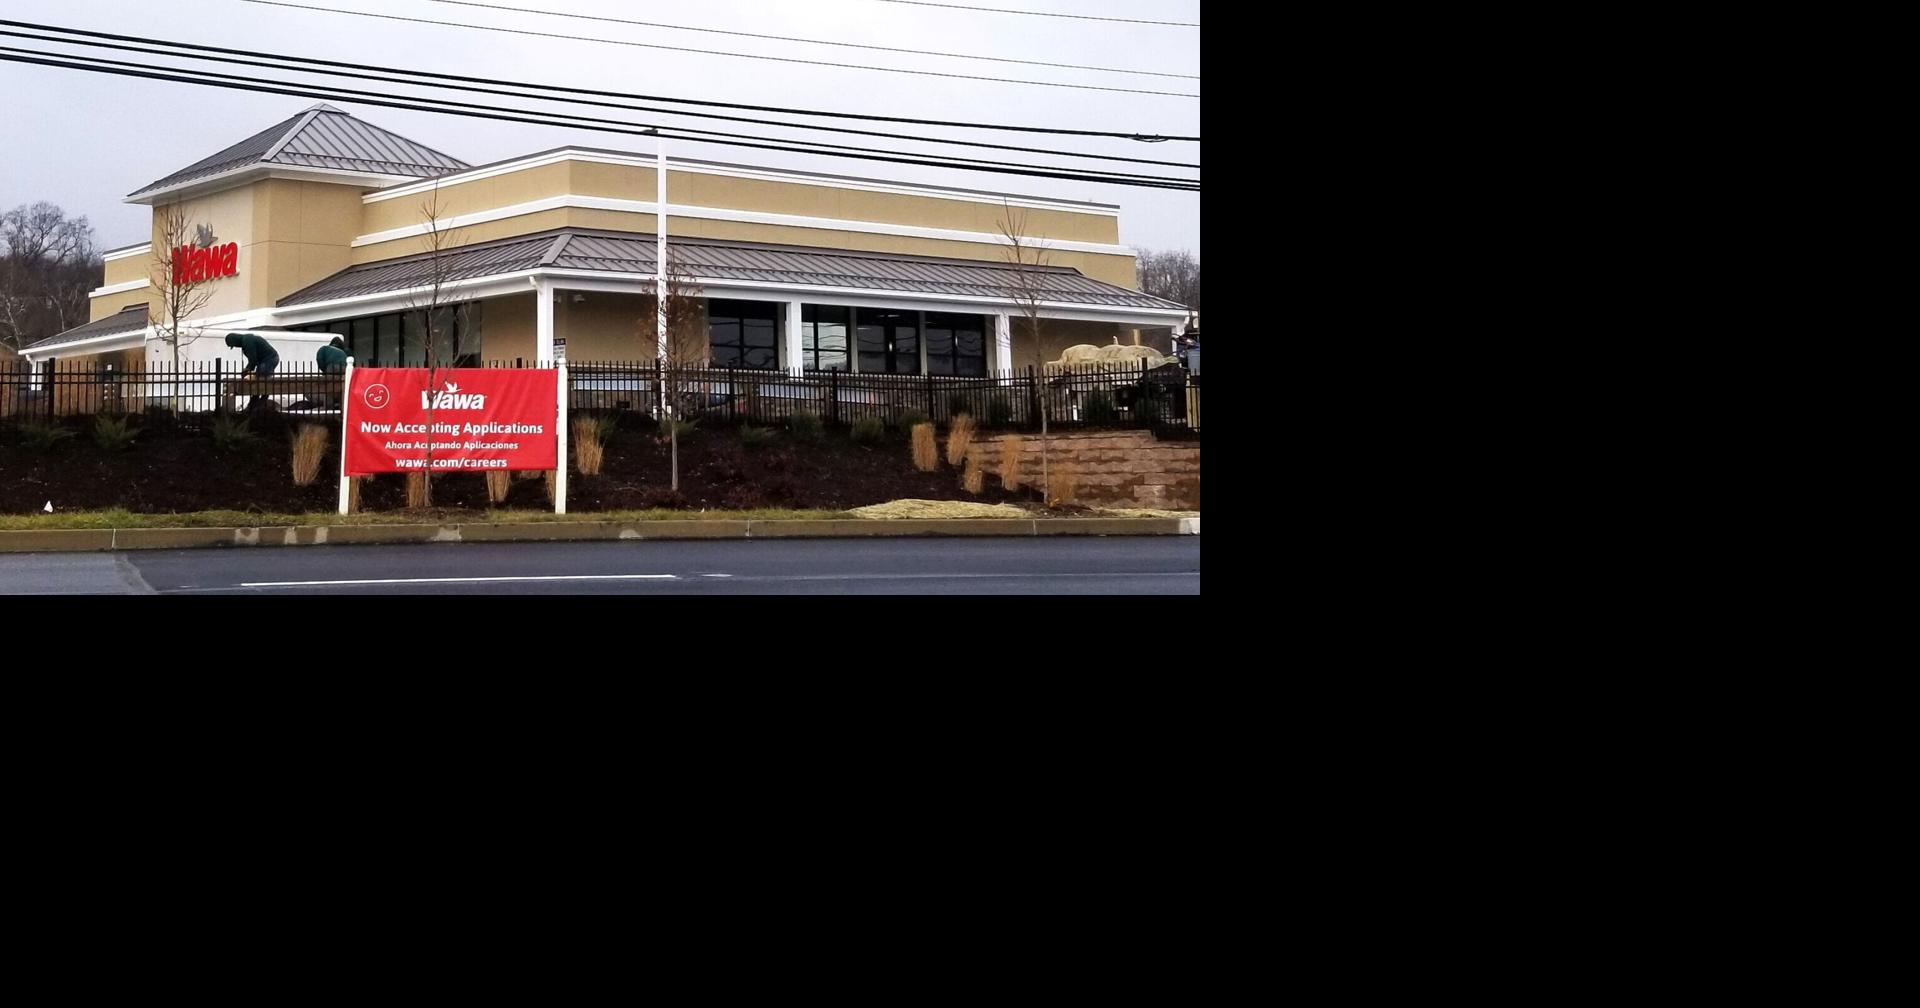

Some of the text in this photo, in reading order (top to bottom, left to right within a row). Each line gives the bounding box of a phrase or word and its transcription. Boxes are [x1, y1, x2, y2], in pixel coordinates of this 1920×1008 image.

[172, 242, 239, 286] Wawa
[421, 390, 485, 410] Wawa
[361, 421, 543, 436] Now Acceting Applications
[385, 441, 412, 449] Ahora
[463, 441, 519, 451] Aplicaciones
